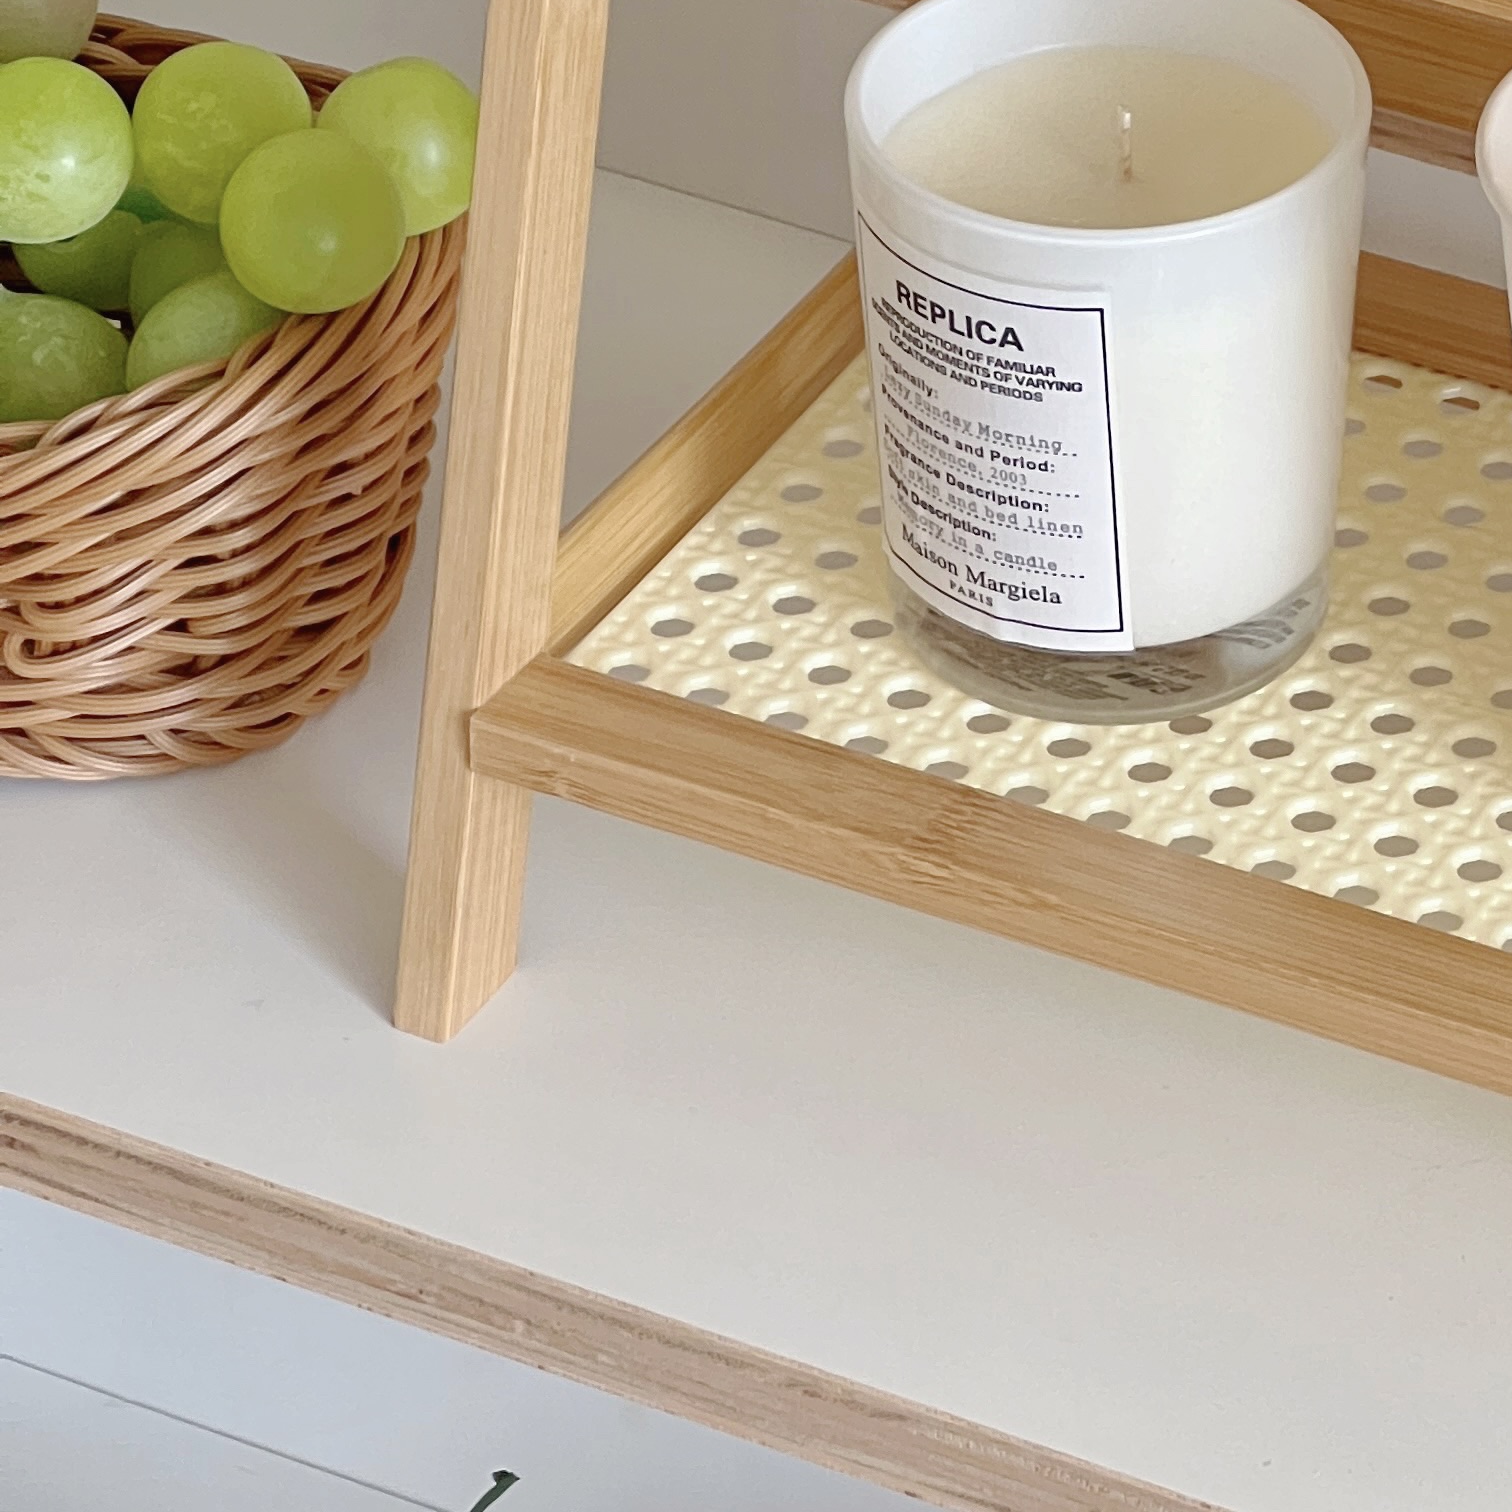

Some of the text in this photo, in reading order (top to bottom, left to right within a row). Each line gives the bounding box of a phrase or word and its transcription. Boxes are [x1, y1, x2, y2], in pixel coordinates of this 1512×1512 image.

[896, 280, 1024, 352] REPLICA
[890, 330, 1043, 402] LOCATIONS AND PERIODS
[925, 344, 990, 378] MOMENTS
[994, 371, 1012, 383] OF
[1014, 374, 1083, 393] VARYING
[966, 349, 984, 363] OF
[986, 356, 1056, 378] FAMILIAR
[978, 421, 1063, 455] Morning
[955, 440, 984, 458] and
[990, 449, 1056, 473] Period:
[946, 472, 1049, 513] Description:
[991, 466, 1027, 486] 2003
[910, 490, 997, 542] Description:
[984, 505, 1018, 525] bed
[1027, 515, 1084, 535] linen
[902, 523, 1063, 605] Maison Margiela
[993, 548, 1058, 572] candle
[949, 579, 994, 607] PARIS
